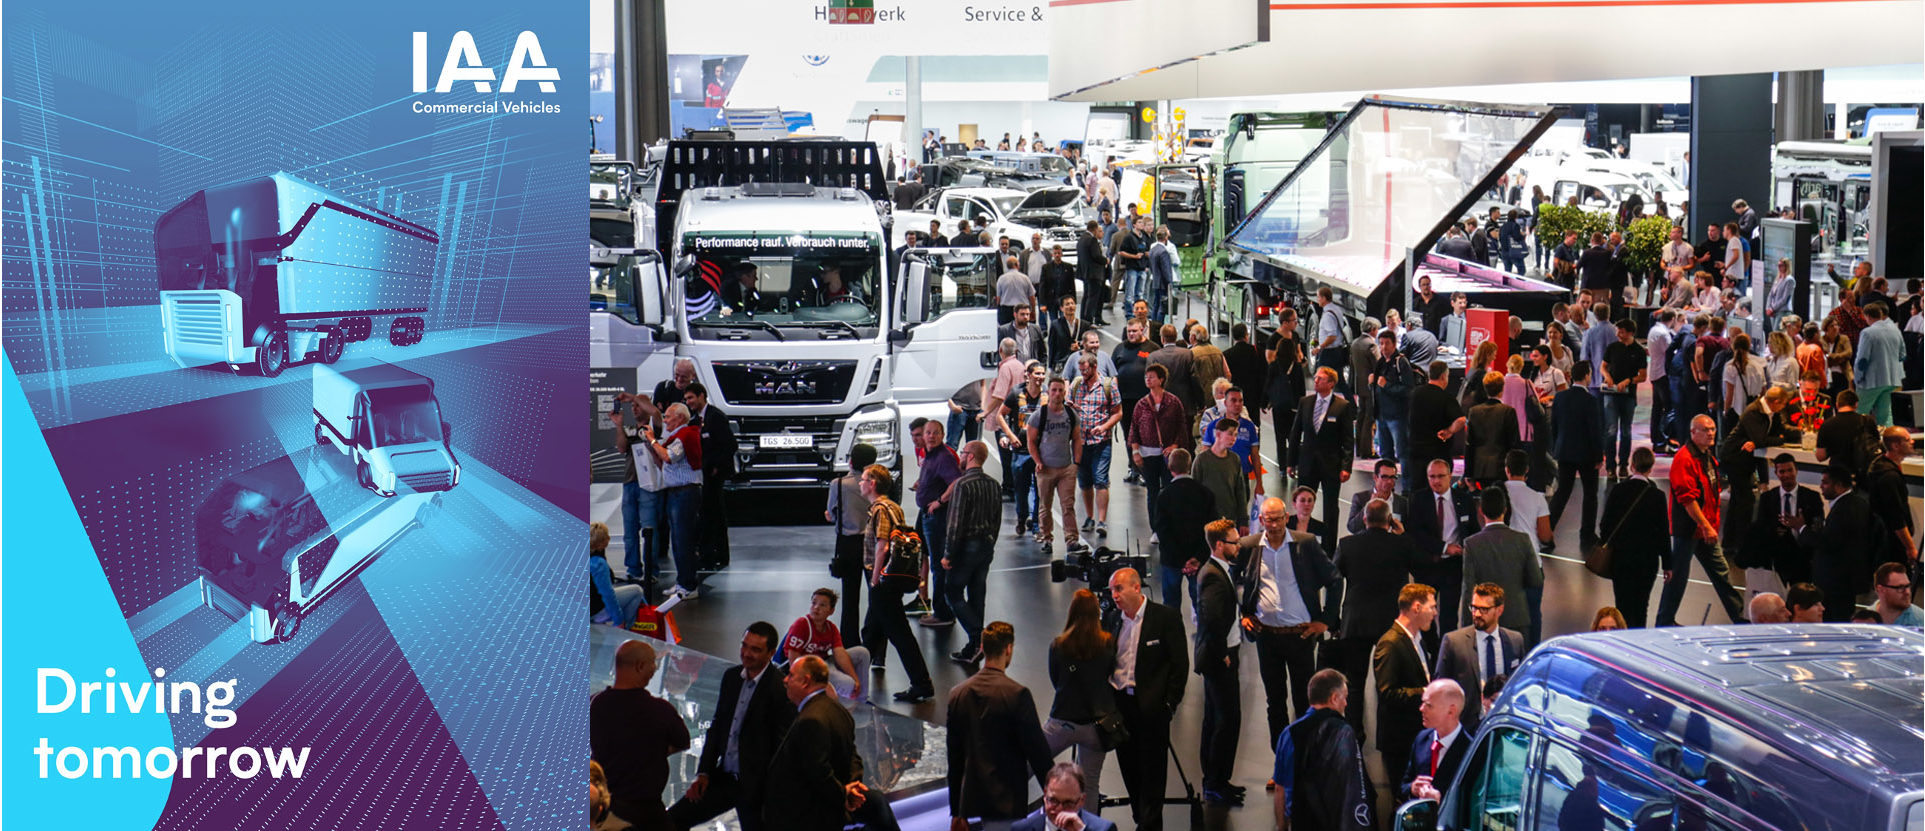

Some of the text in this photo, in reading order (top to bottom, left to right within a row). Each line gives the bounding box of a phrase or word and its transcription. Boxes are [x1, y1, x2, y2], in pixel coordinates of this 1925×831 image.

[815, 6, 905, 21] Herk
[965, 6, 1043, 21] Service &
[413, 31, 560, 92] IAA
[413, 101, 560, 113] Commercial Vehicles
[695, 237, 869, 248] Performance rauf. Verbrauch runter.
[755, 382, 816, 394] MAN
[789, 636, 804, 647] 97
[37, 668, 237, 729] Driving
[34, 738, 311, 779] tomorrow
